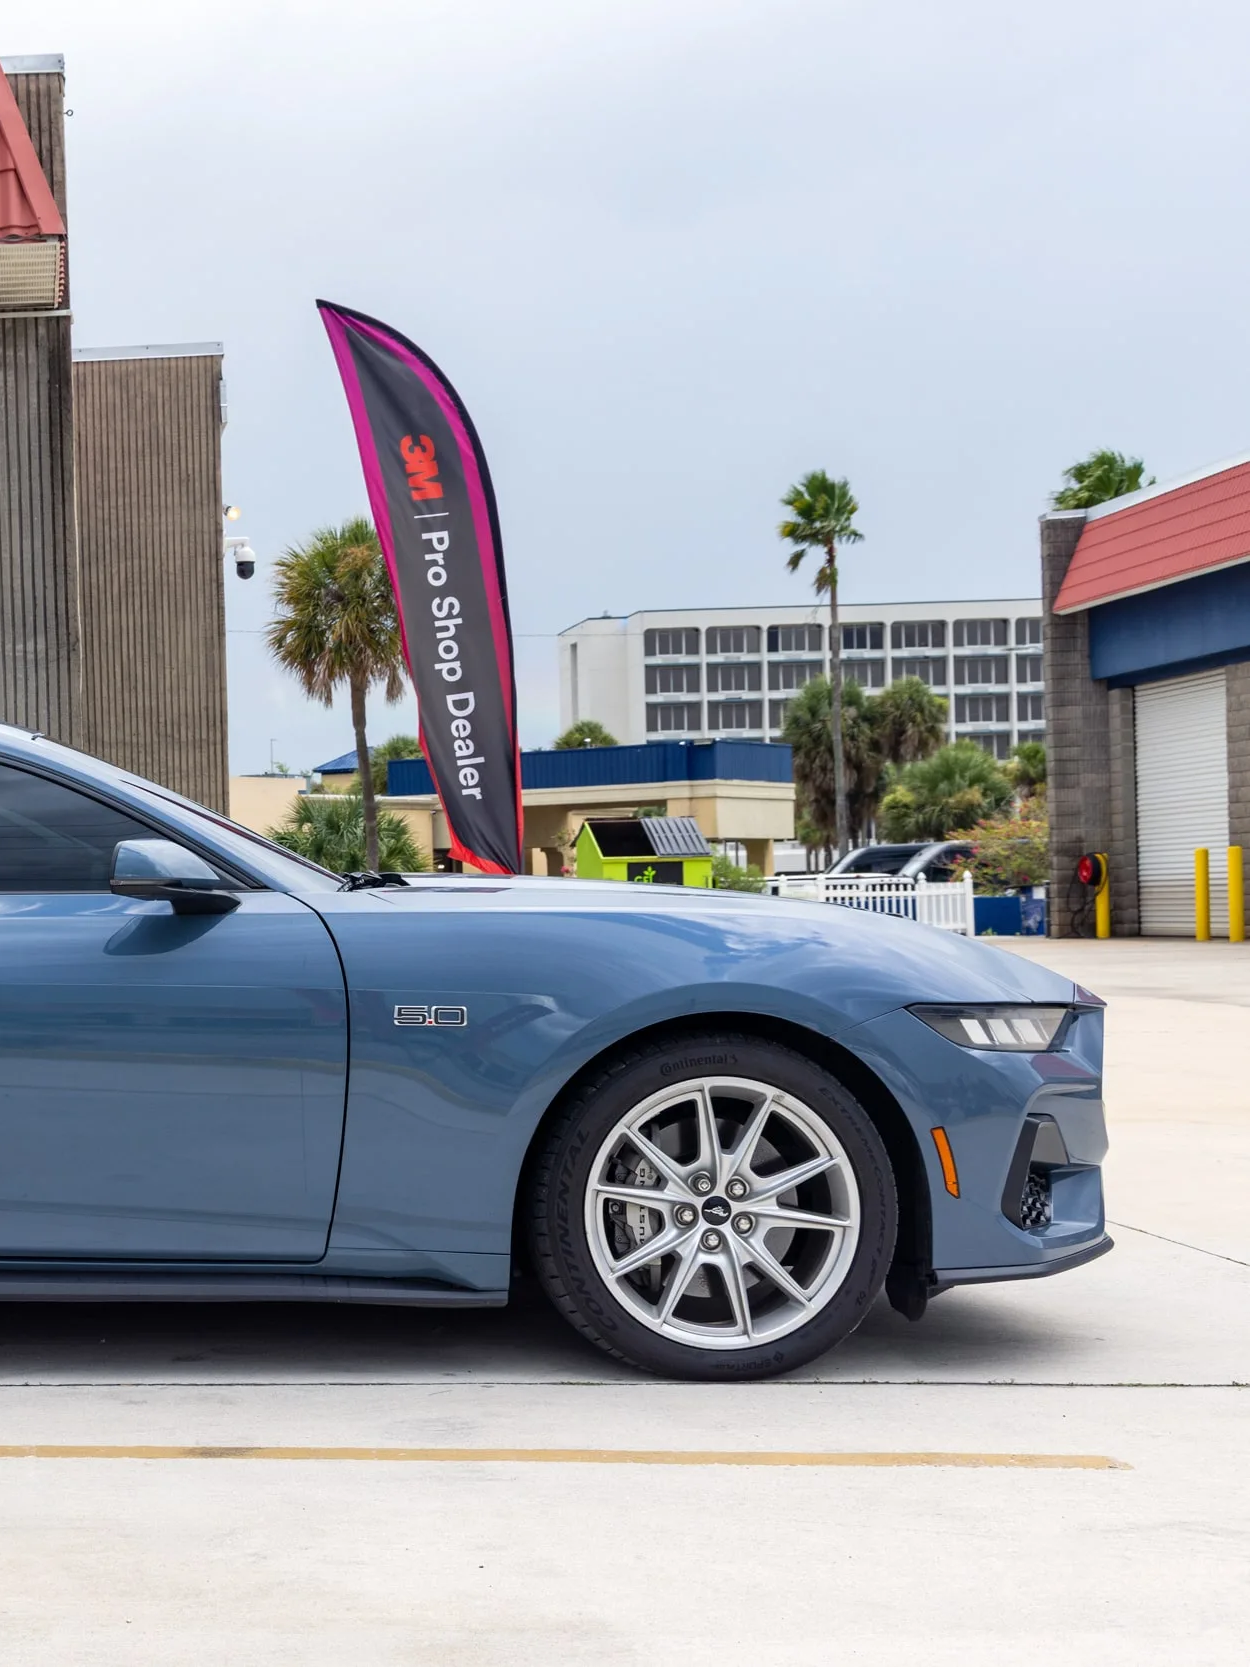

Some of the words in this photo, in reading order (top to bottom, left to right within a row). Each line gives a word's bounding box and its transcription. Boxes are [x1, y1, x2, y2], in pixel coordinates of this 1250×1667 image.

[401, 434, 445, 501] 3M
[421, 530, 450, 587] Pro
[431, 596, 463, 682] Shop
[446, 691, 485, 800] Dealer
[393, 1005, 467, 1026] 5.0
